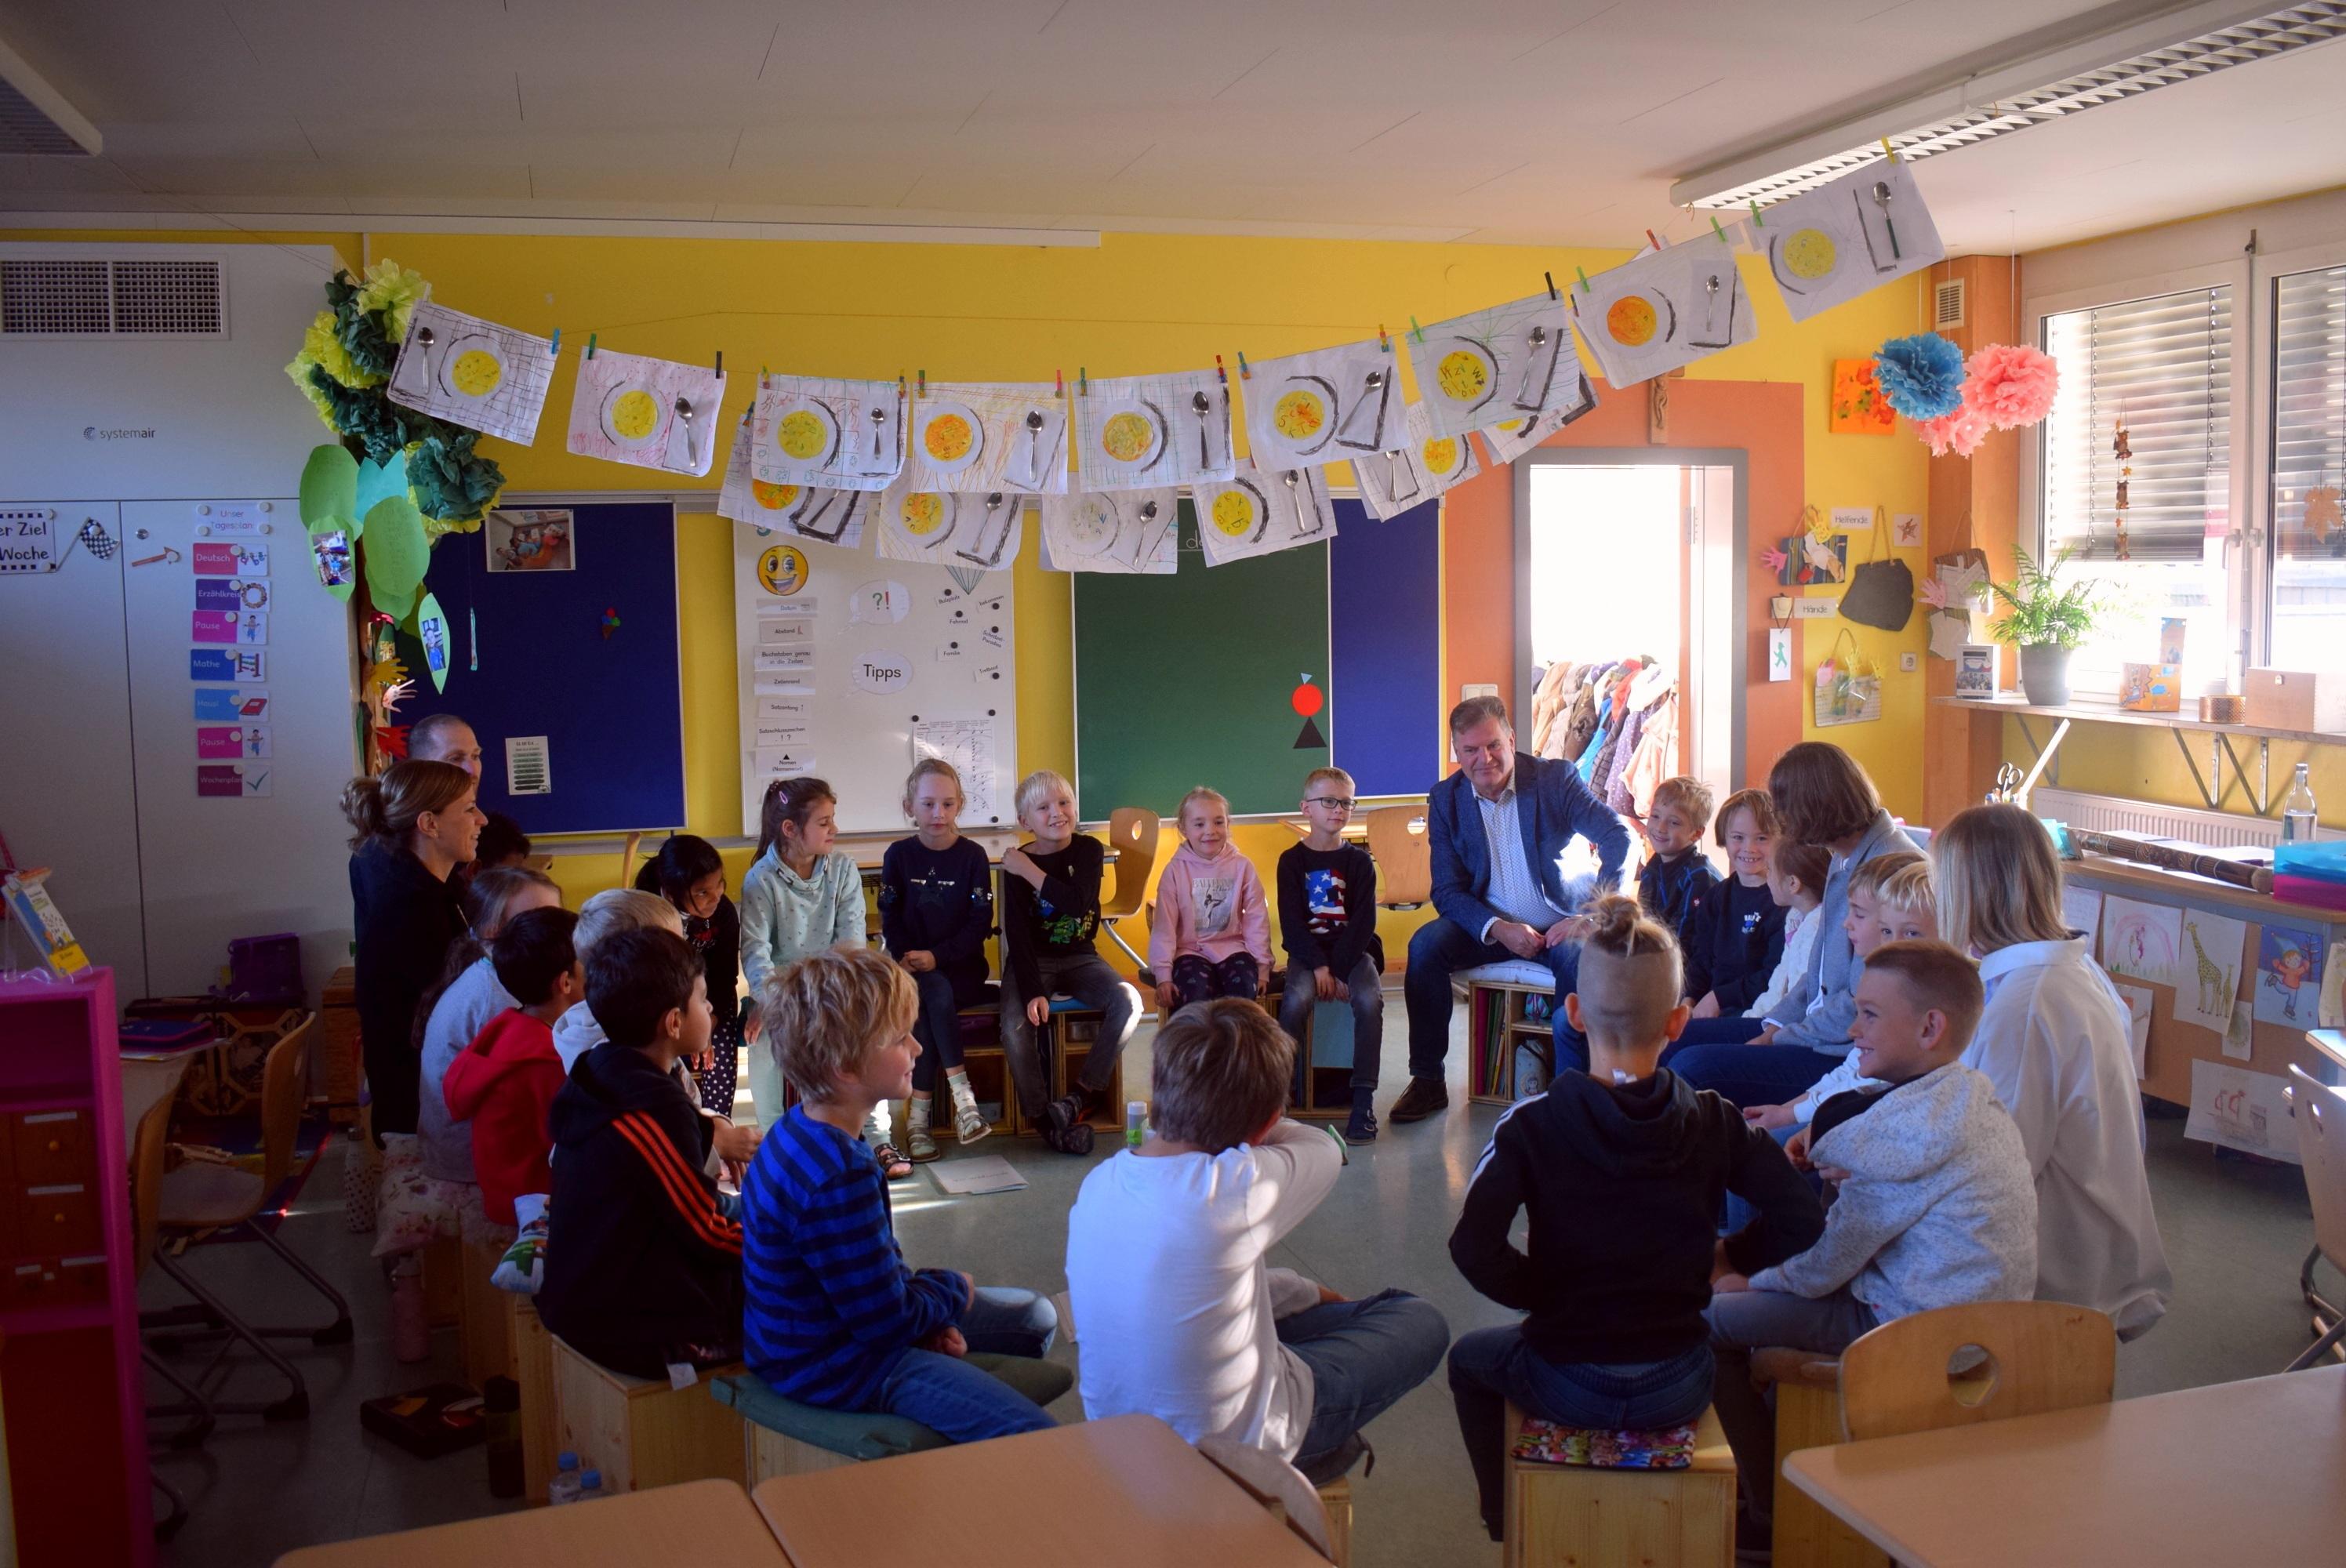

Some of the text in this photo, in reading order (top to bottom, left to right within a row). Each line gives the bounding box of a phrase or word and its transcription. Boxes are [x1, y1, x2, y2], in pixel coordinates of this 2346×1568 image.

[100, 427, 156, 441] systemair
[1835, 515, 1868, 524] Helfende
[18, 521, 47, 536] Ziel
[0, 546, 49, 561] Woche
[196, 554, 231, 562] Deutsch
[1803, 605, 1828, 614] Hände
[195, 621, 220, 630] Pause
[193, 659, 220, 668] Mathe
[863, 664, 902, 682] Tipps
[200, 738, 226, 746] Pause
[200, 776, 242, 785] Wochenplan
